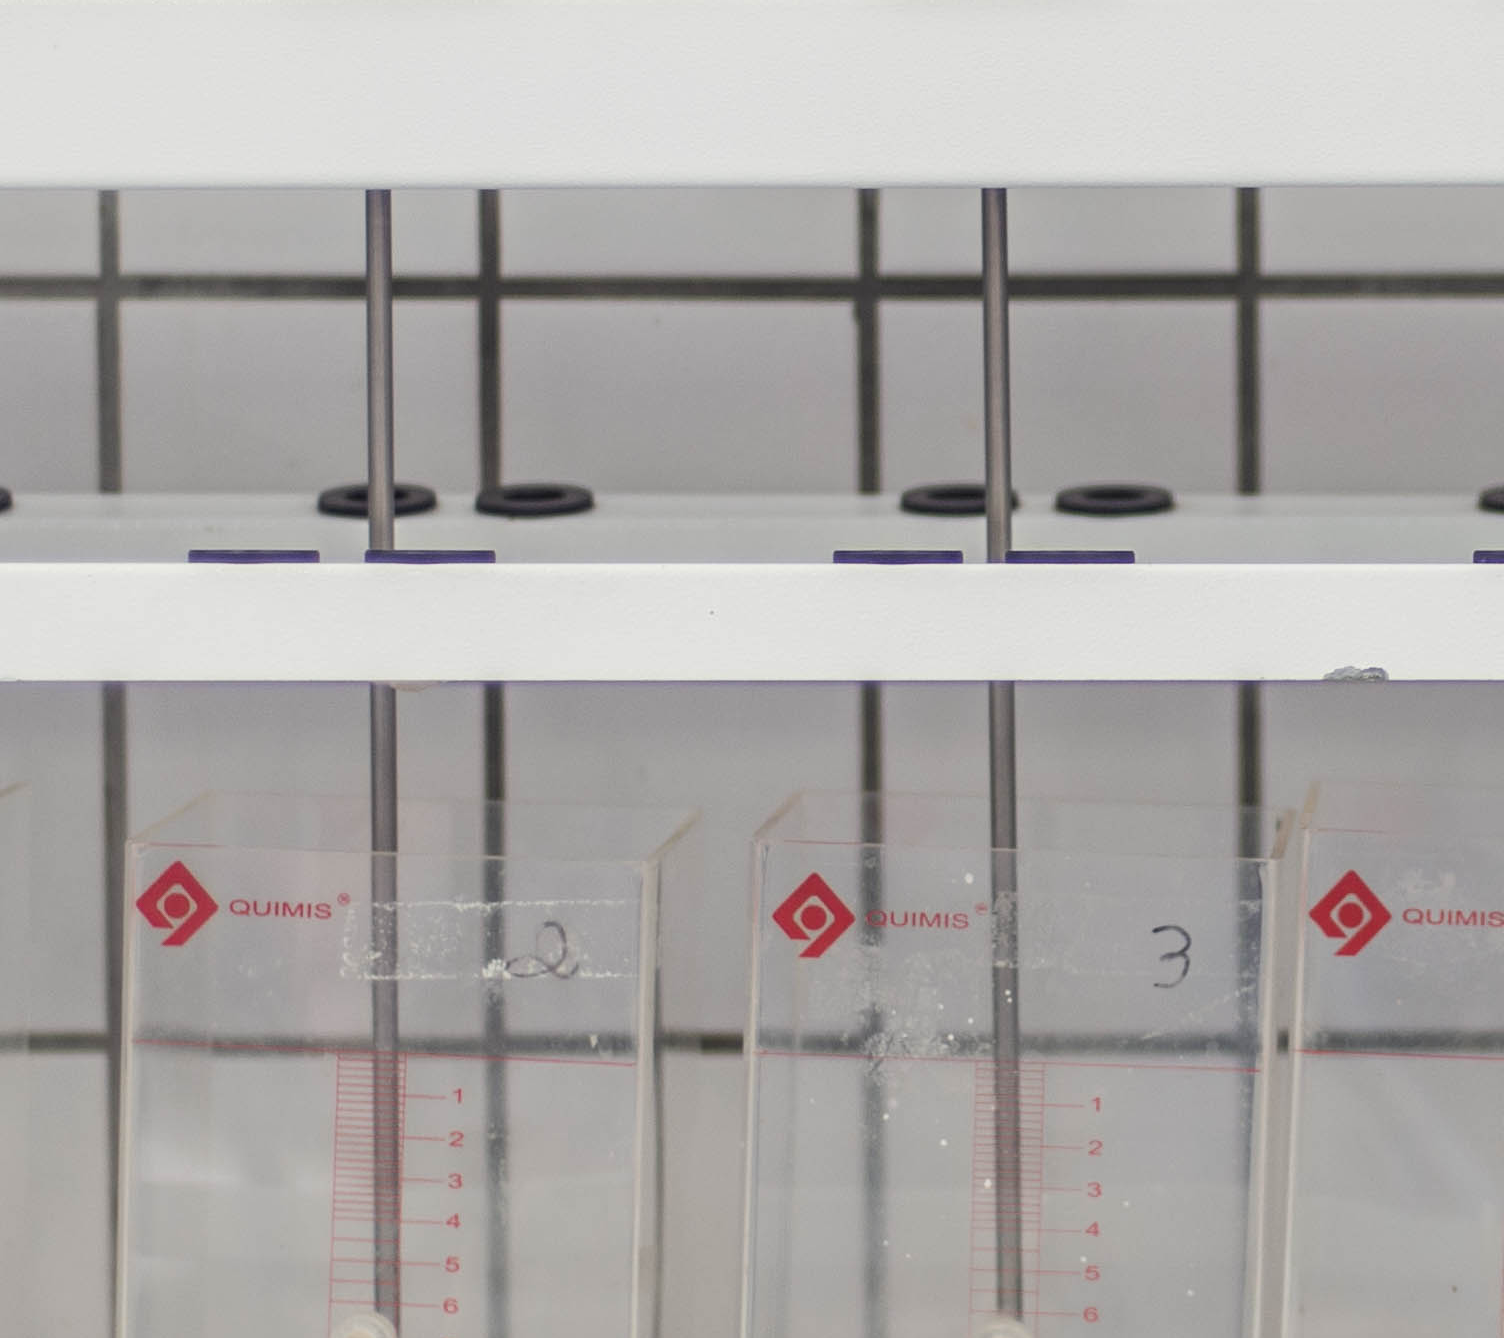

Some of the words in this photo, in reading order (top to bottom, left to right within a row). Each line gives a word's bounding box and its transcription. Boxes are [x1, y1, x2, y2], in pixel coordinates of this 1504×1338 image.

[504, 919, 581, 980] 2
[1152, 924, 1193, 989] 3
[453, 1088, 464, 1104] 1
[1091, 1096, 1102, 1113] 1
[448, 1129, 465, 1148] 2
[1088, 1140, 1103, 1157] 2
[447, 1172, 464, 1190] 3
[1087, 1181, 1103, 1198] 3
[445, 1213, 462, 1230] 4
[1084, 1221, 1101, 1238] 4
[444, 1256, 461, 1274] 5
[1084, 1264, 1101, 1282] 5
[442, 1297, 459, 1317] 6
[1082, 1306, 1100, 1324] 6
